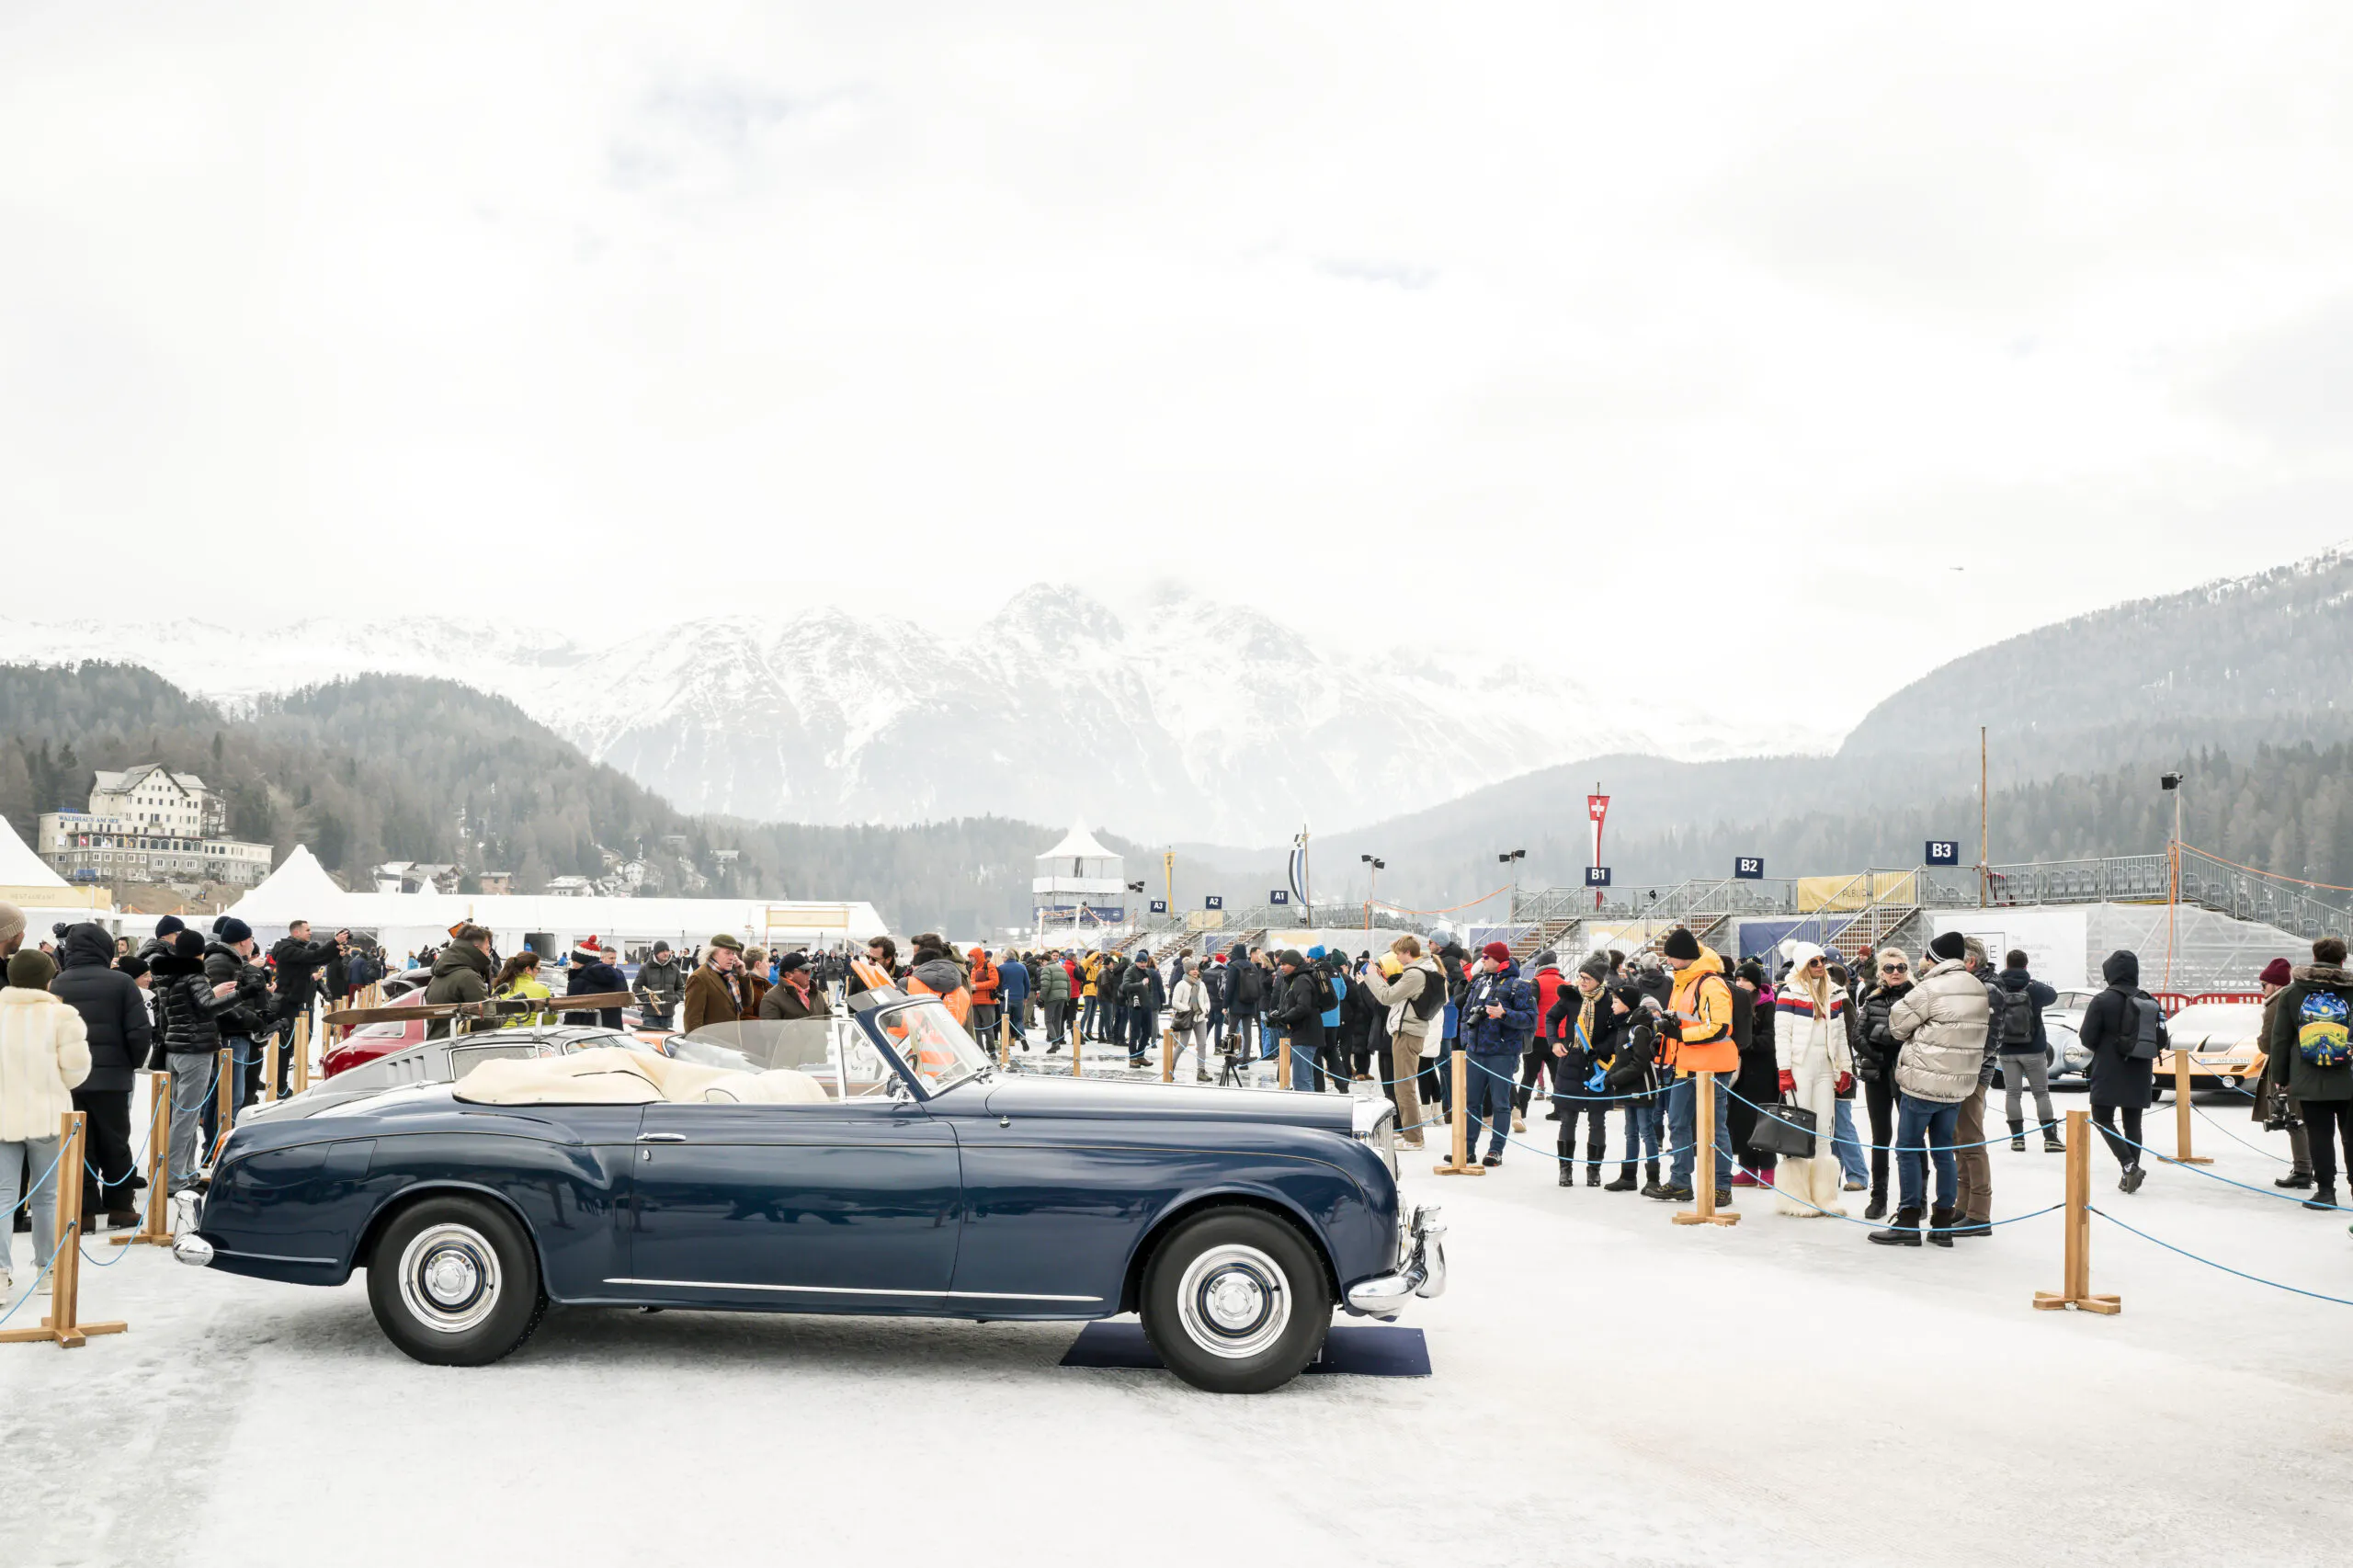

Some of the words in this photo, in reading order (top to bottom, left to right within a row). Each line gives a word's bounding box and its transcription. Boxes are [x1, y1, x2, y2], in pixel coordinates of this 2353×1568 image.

[1932, 843, 1951, 858] B3
[1741, 858, 1758, 872] B2
[1591, 869, 1605, 881] B1
